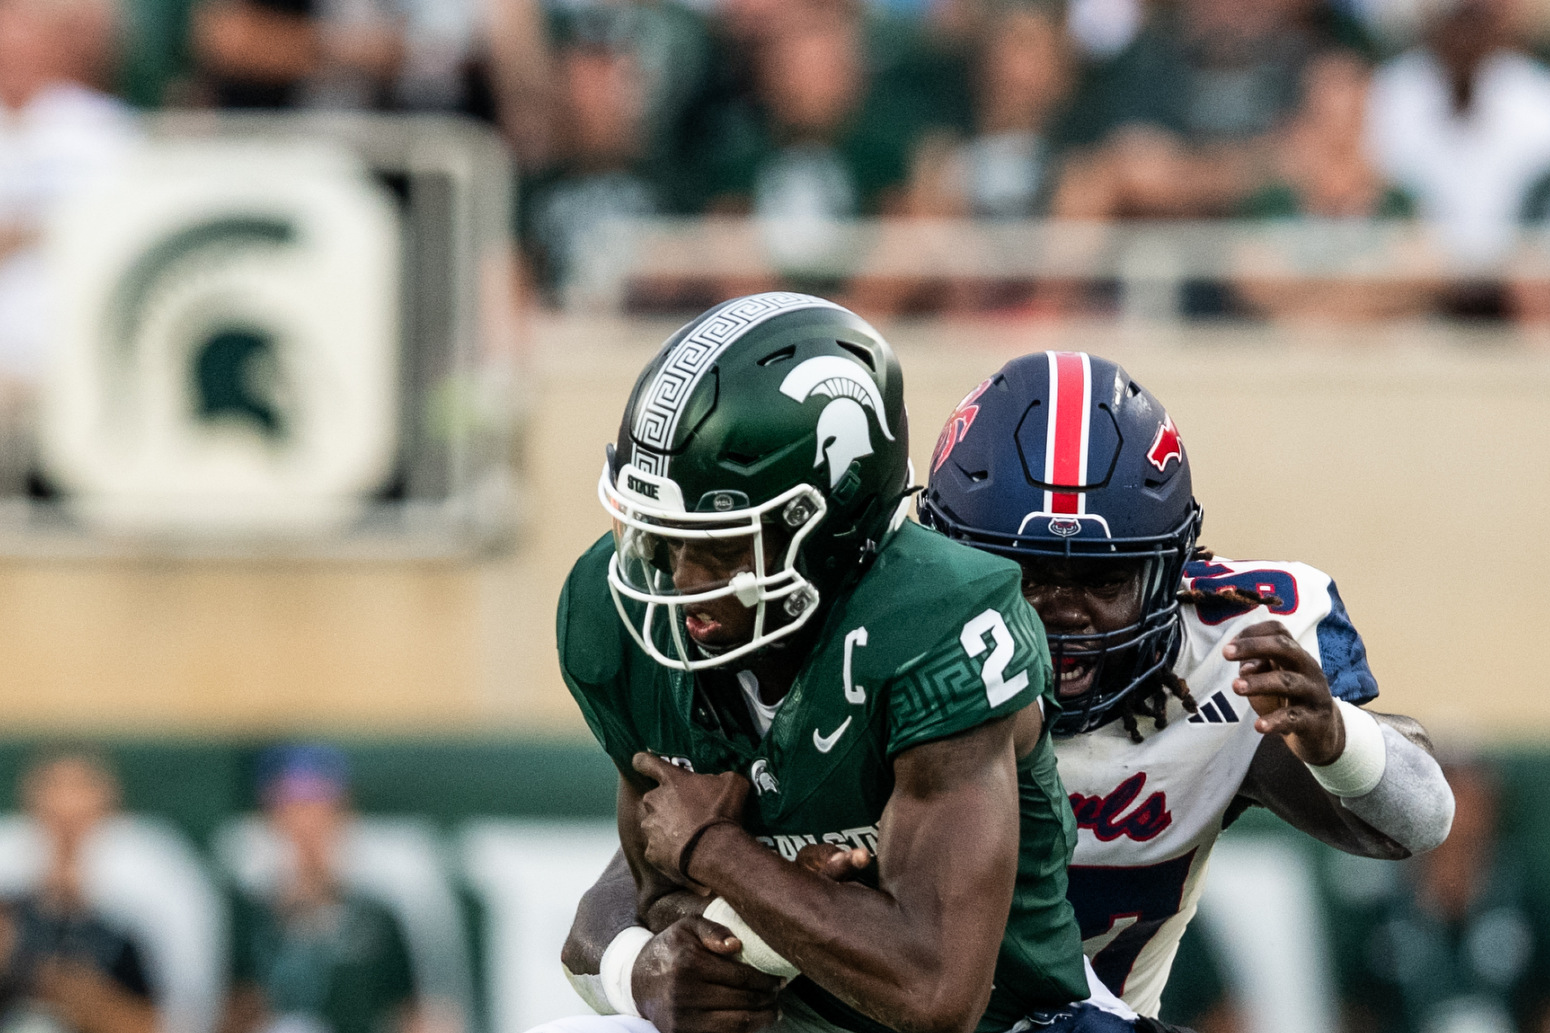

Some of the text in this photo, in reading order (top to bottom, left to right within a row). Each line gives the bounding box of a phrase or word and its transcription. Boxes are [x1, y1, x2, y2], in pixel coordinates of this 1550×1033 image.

[627, 473, 660, 501] STATE
[843, 626, 868, 705] C
[959, 608, 1030, 709] 2
